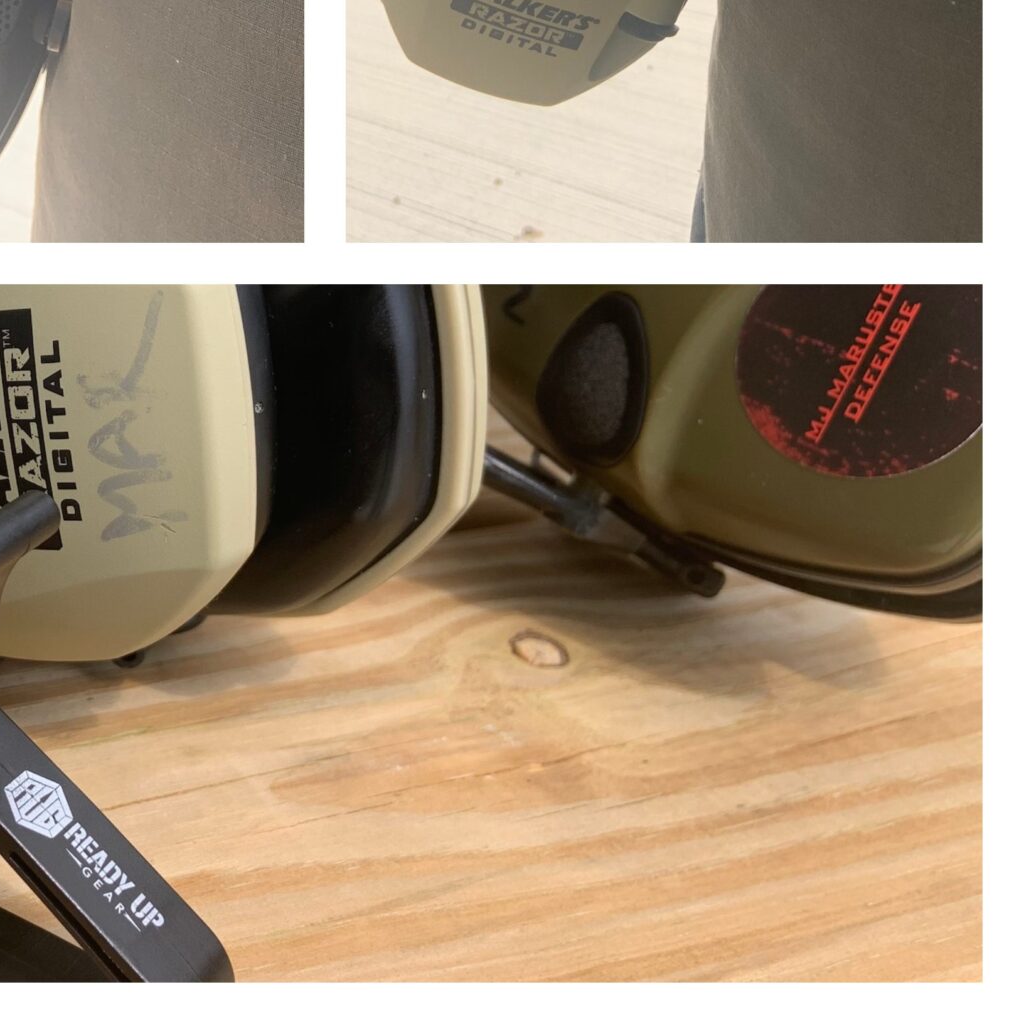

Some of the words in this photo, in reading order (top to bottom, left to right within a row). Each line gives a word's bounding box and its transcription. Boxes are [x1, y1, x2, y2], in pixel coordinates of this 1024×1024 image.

[461, 18, 557, 57] DIGITAL
[468, 2, 565, 45] RAZOR
[844, 300, 919, 422] DEFENSE
[41, 340, 82, 521] DIGITAL
[804, 406, 833, 443] MJ
[64, 822, 135, 895] READY
[131, 893, 165, 927] UP
[82, 866, 125, 914] GEAR
